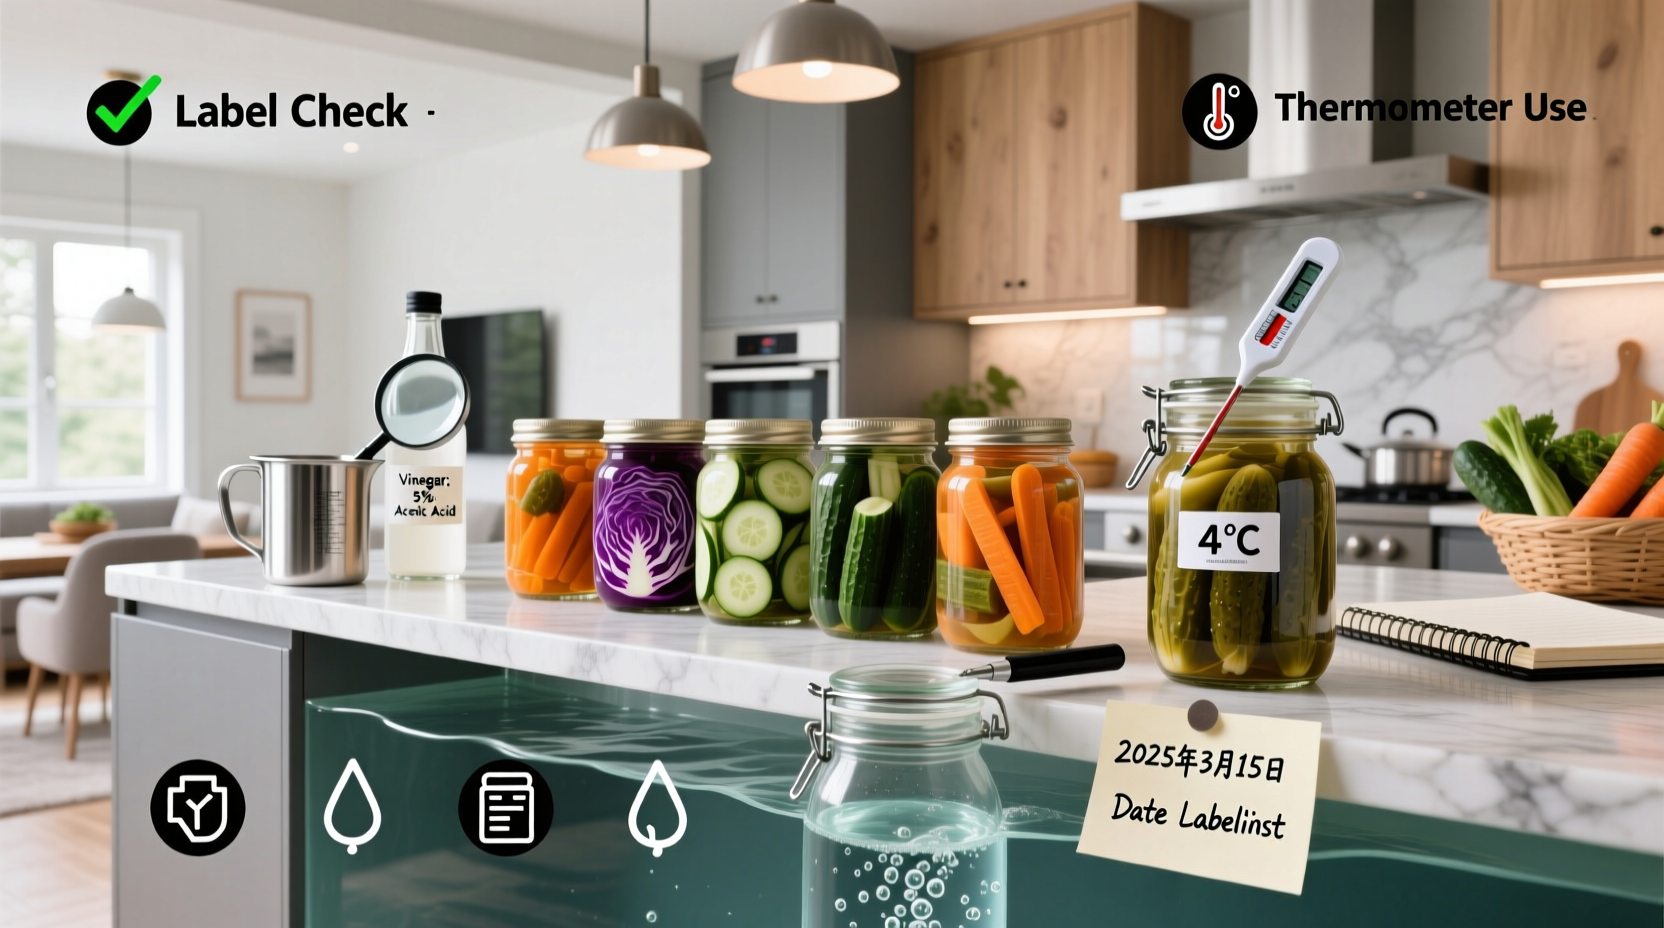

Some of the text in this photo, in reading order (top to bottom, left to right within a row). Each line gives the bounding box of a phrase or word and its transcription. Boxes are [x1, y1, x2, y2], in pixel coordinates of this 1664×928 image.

[398, 472, 450, 490] Vinegar:
[431, 504, 456, 517] Acid
[1198, 523, 1260, 556] 4°C
[1114, 739, 1285, 783] 2025年3月15日
[1111, 792, 1168, 825] Date
